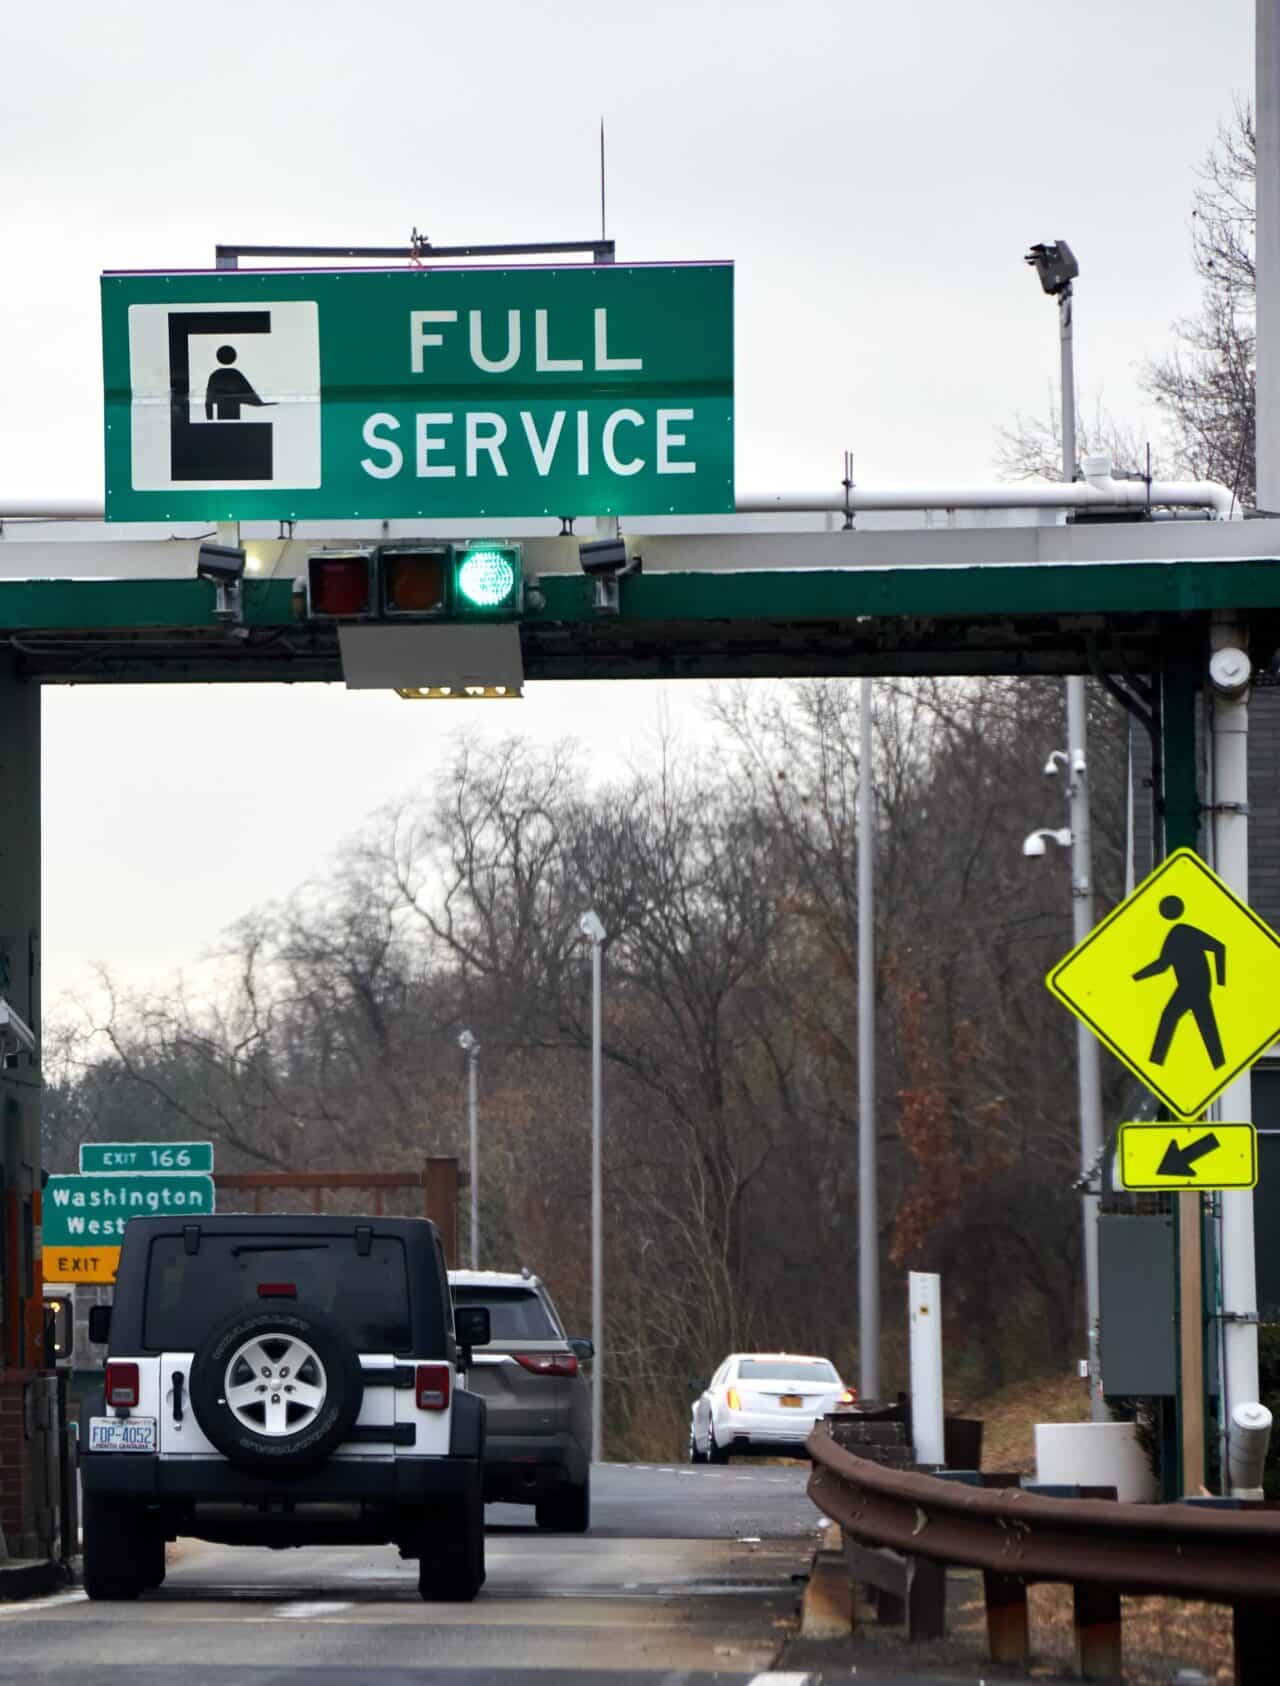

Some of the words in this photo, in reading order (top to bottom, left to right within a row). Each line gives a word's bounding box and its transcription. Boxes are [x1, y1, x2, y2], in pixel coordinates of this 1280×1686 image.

[410, 308, 642, 373] FULL
[360, 409, 696, 479] SERVICE
[103, 1152, 137, 1165] EXIT
[151, 1150, 191, 1166] 166
[52, 1187, 203, 1211] Washington
[67, 1216, 126, 1235] West
[57, 1257, 100, 1272] EXIT
